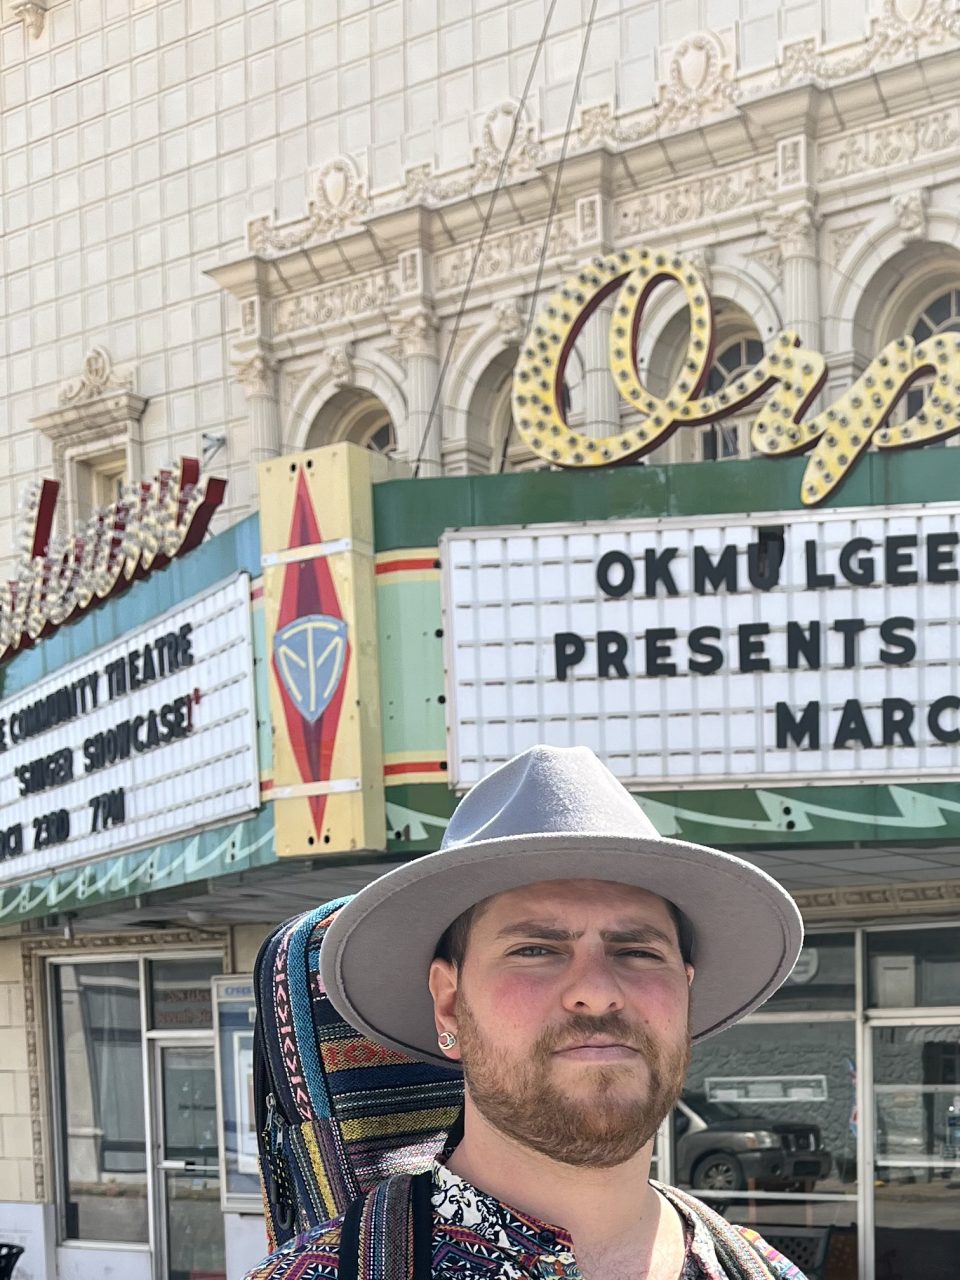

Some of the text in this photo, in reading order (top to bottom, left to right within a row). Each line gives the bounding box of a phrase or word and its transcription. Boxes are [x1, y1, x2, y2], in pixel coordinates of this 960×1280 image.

[595, 531, 959, 598] OKMULGEE
[105, 623, 194, 700] THEATRE
[554, 616, 917, 681] PRESENTS
